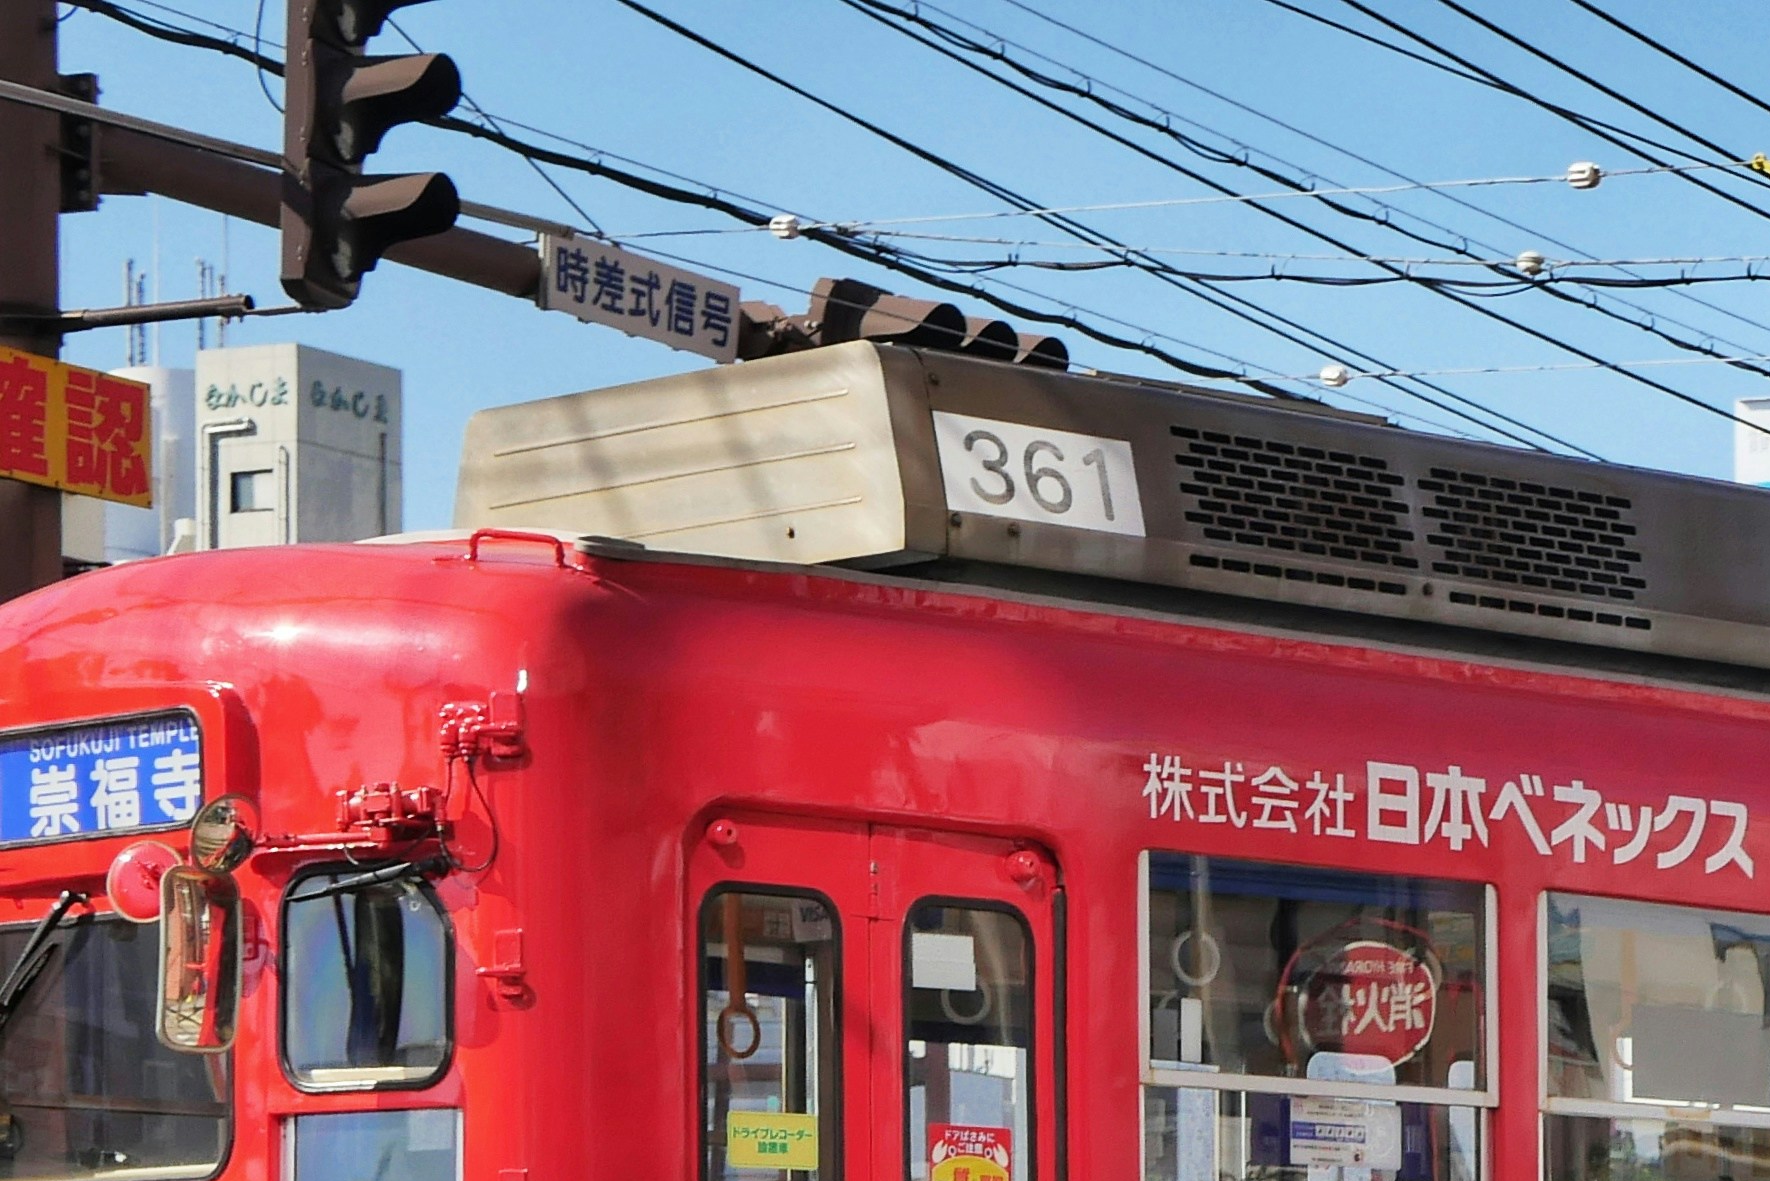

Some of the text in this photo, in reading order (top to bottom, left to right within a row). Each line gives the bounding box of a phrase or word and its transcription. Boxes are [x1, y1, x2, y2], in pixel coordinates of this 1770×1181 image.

[556, 247, 732, 348] 時差式信号
[963, 429, 1115, 522] 361
[30, 716, 200, 763] SOFUKUJI TEMPLE
[30, 748, 200, 838] 崇福寺
[1141, 752, 1754, 880] 株式会社日本ベネックス
